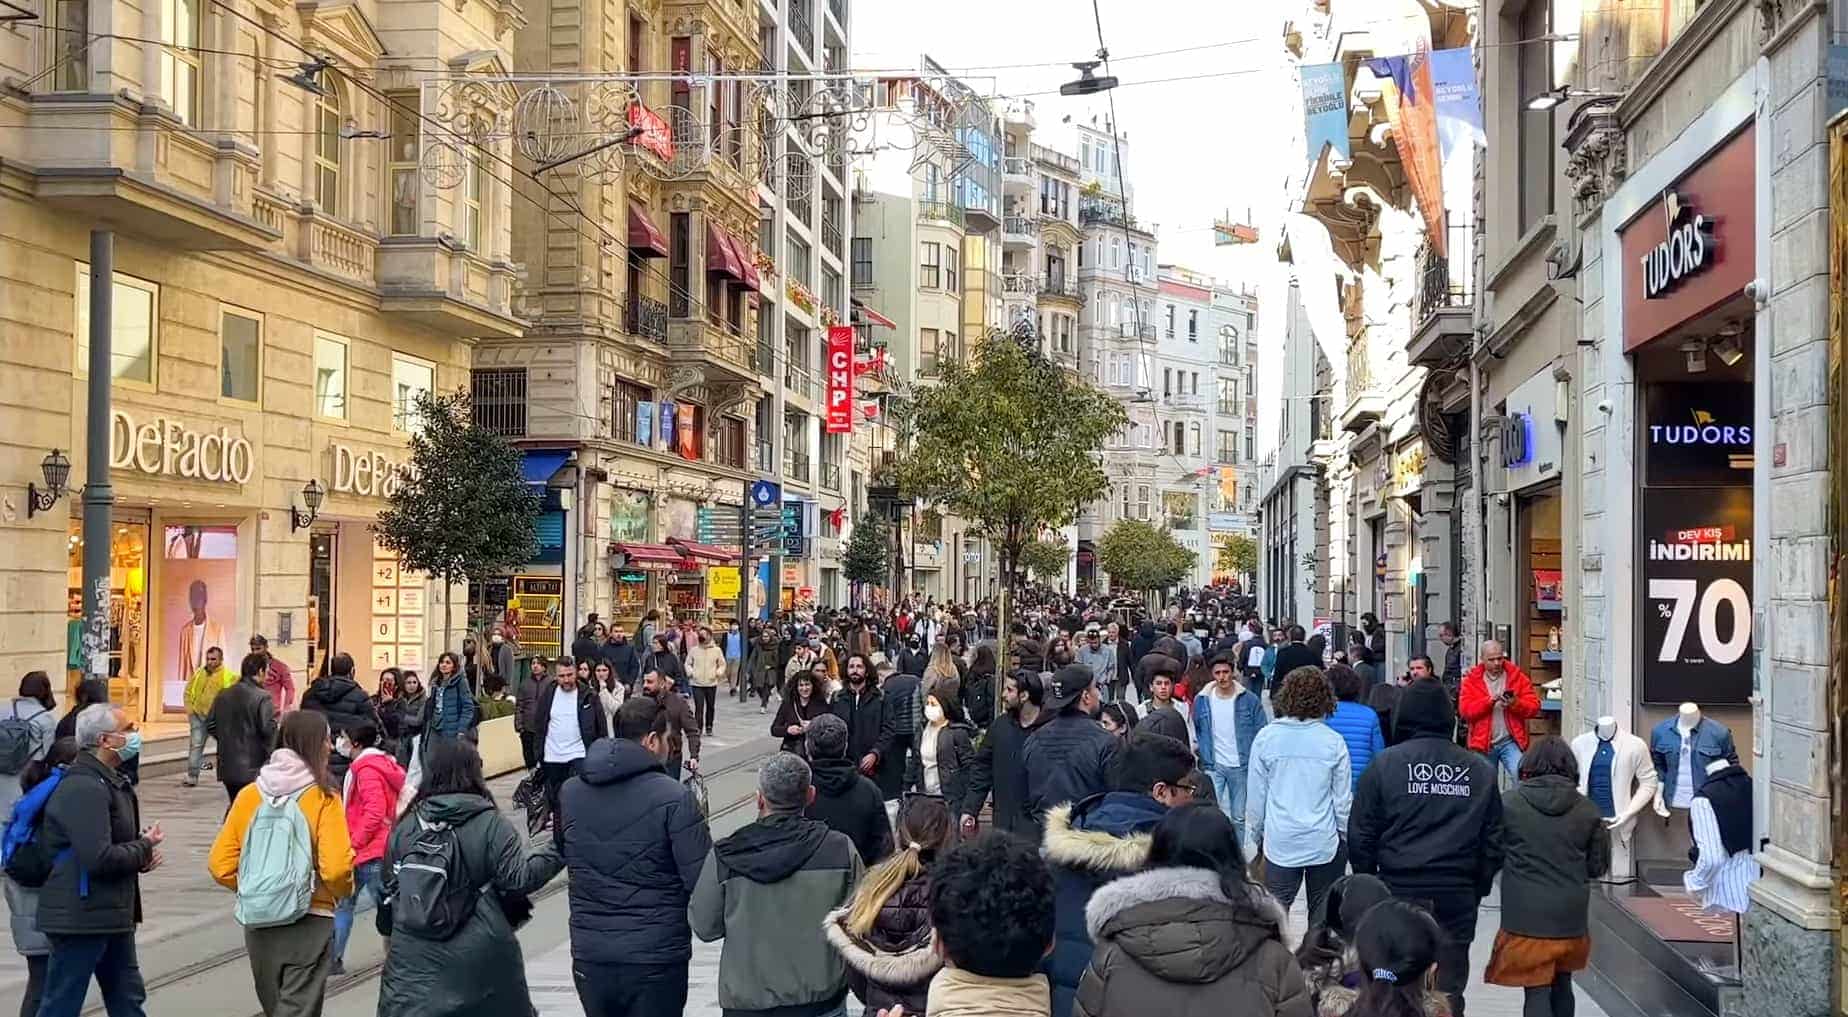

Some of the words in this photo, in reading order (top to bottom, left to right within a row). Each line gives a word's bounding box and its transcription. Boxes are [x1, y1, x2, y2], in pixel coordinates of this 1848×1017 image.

[1641, 214, 1703, 300] TUDORS
[832, 351, 848, 407] CHP
[1650, 425, 1751, 444] TUDORS
[110, 409, 254, 484] DeFacto
[1678, 530, 1701, 541] DEV
[1650, 538, 1751, 561] İNDİRİMİ
[377, 567, 392, 580] +2
[377, 595, 391, 607] +1
[380, 623, 388, 635] 0
[1648, 578, 1751, 665] 70
[1408, 782, 1429, 794] LOVE
[1430, 783, 1470, 797] MOSCHINO
